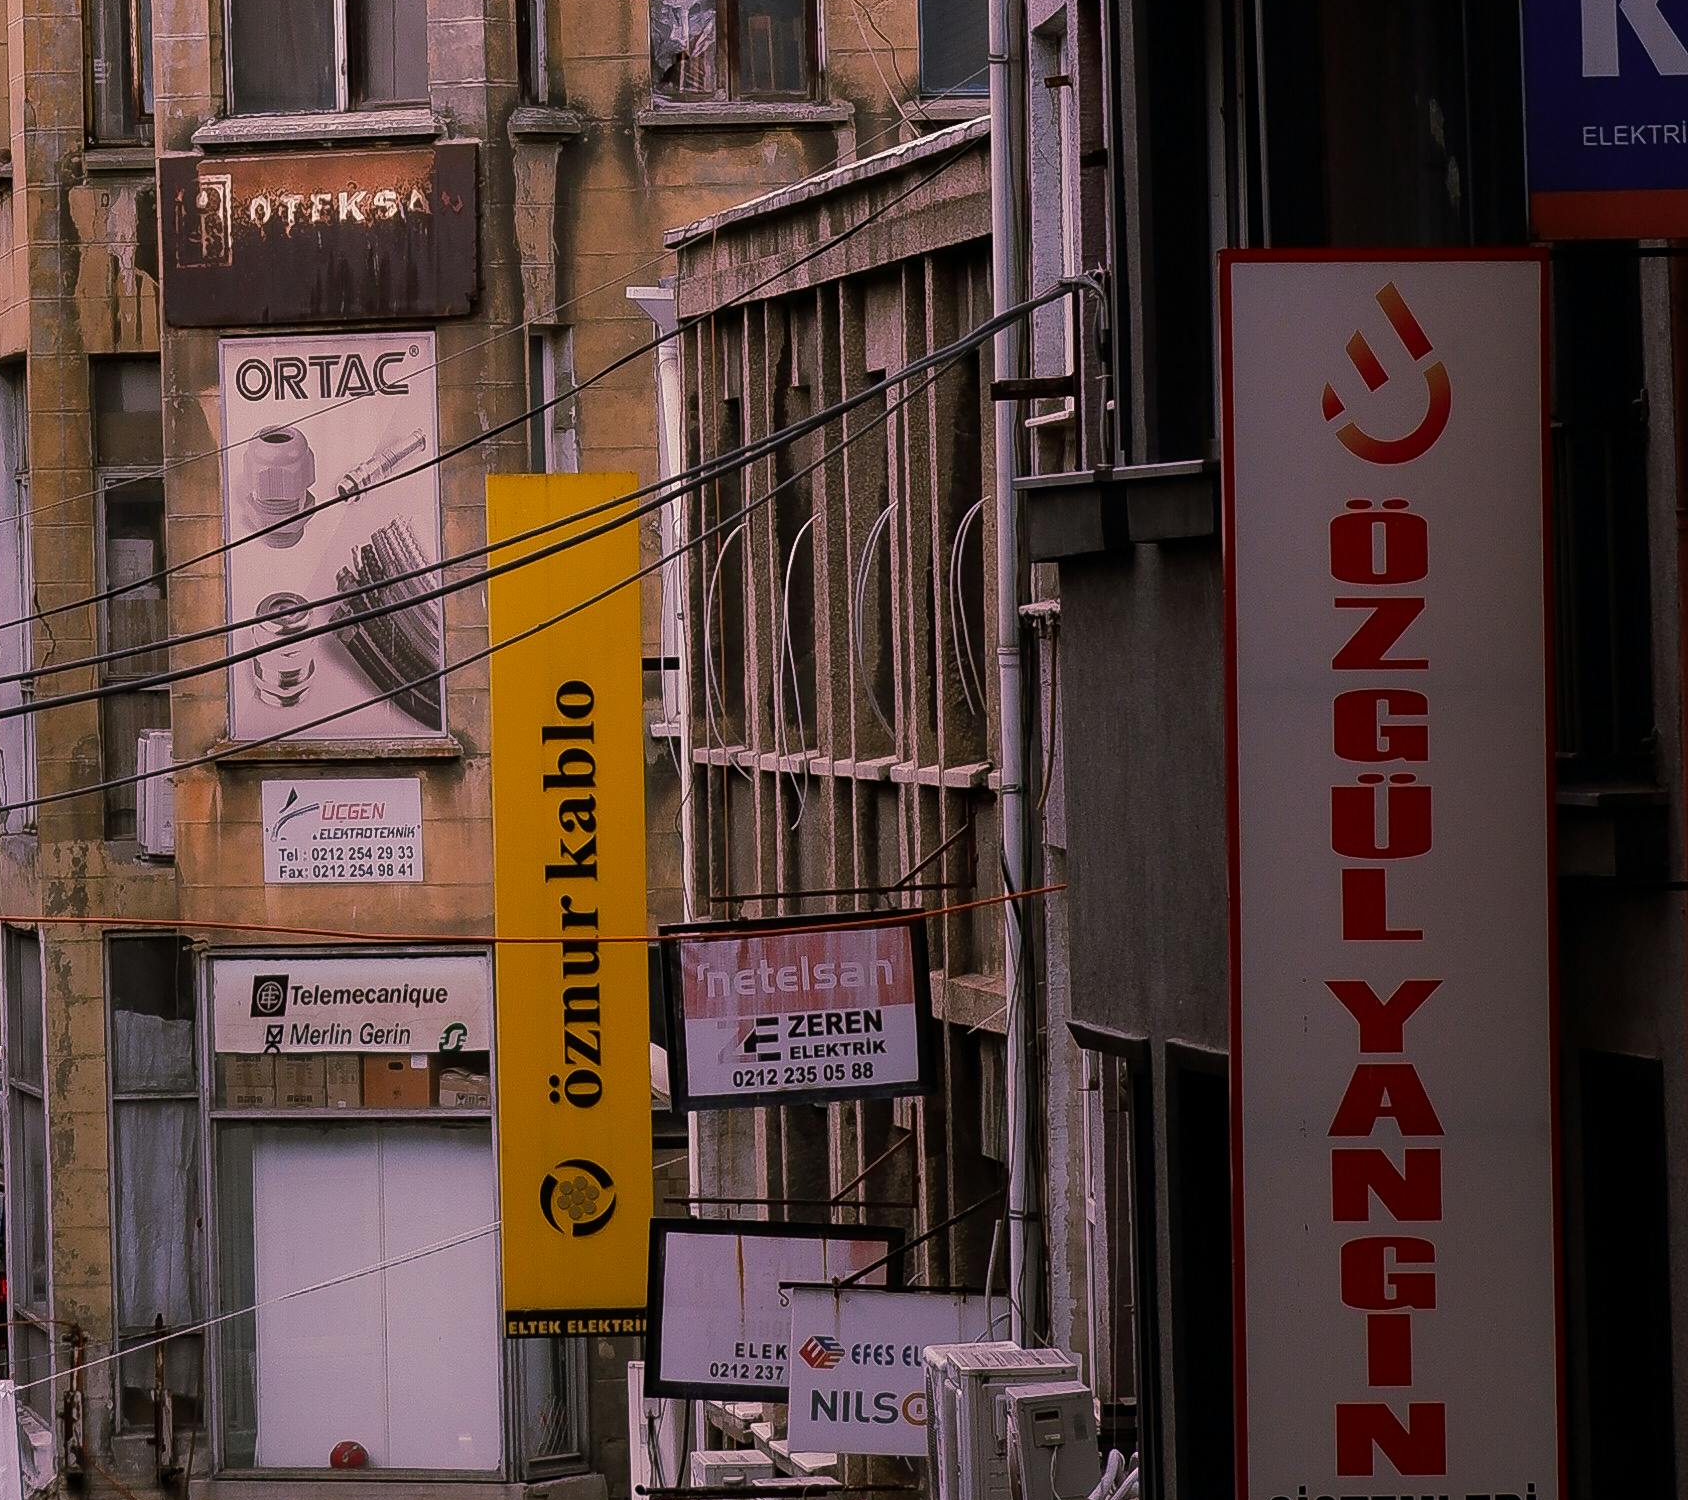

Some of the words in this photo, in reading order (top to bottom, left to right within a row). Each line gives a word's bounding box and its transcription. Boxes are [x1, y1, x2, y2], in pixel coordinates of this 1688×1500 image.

[1582, 119, 1688, 147] ELEKTRİ
[235, 350, 409, 403] ORTAC
[542, 677, 598, 882] kablo
[321, 800, 387, 824] ÜÇGEN
[318, 823, 416, 841] ELEKTROTEKNİK
[278, 847, 299, 862] Tel
[312, 847, 344, 862] 0212
[348, 847, 373, 861] 254
[377, 846, 393, 860] 29
[397, 845, 414, 860] 33
[278, 865, 310, 880] Fax:
[312, 864, 346, 879] 0212
[349, 864, 374, 878] 254
[378, 864, 394, 878] 98
[397, 863, 413, 877] 41
[290, 983, 450, 1008] Telemecanique
[549, 892, 604, 1110] öznur
[289, 1022, 353, 1047] Merlin
[359, 1022, 411, 1046] Gerin
[787, 1008, 884, 1039] ZEREN
[789, 1037, 888, 1061] ELEKTRİK
[732, 1068, 779, 1088] 0212
[783, 1066, 819, 1085] 235
[822, 1063, 845, 1083] 05
[851, 1061, 874, 1080] 88
[1324, 980, 1447, 1477] YANGIN
[507, 1320, 562, 1336] ELTEK
[734, 1342, 788, 1360] ELEK
[850, 1343, 895, 1367] EFES
[709, 1362, 750, 1381] 0212
[754, 1363, 784, 1382] 237
